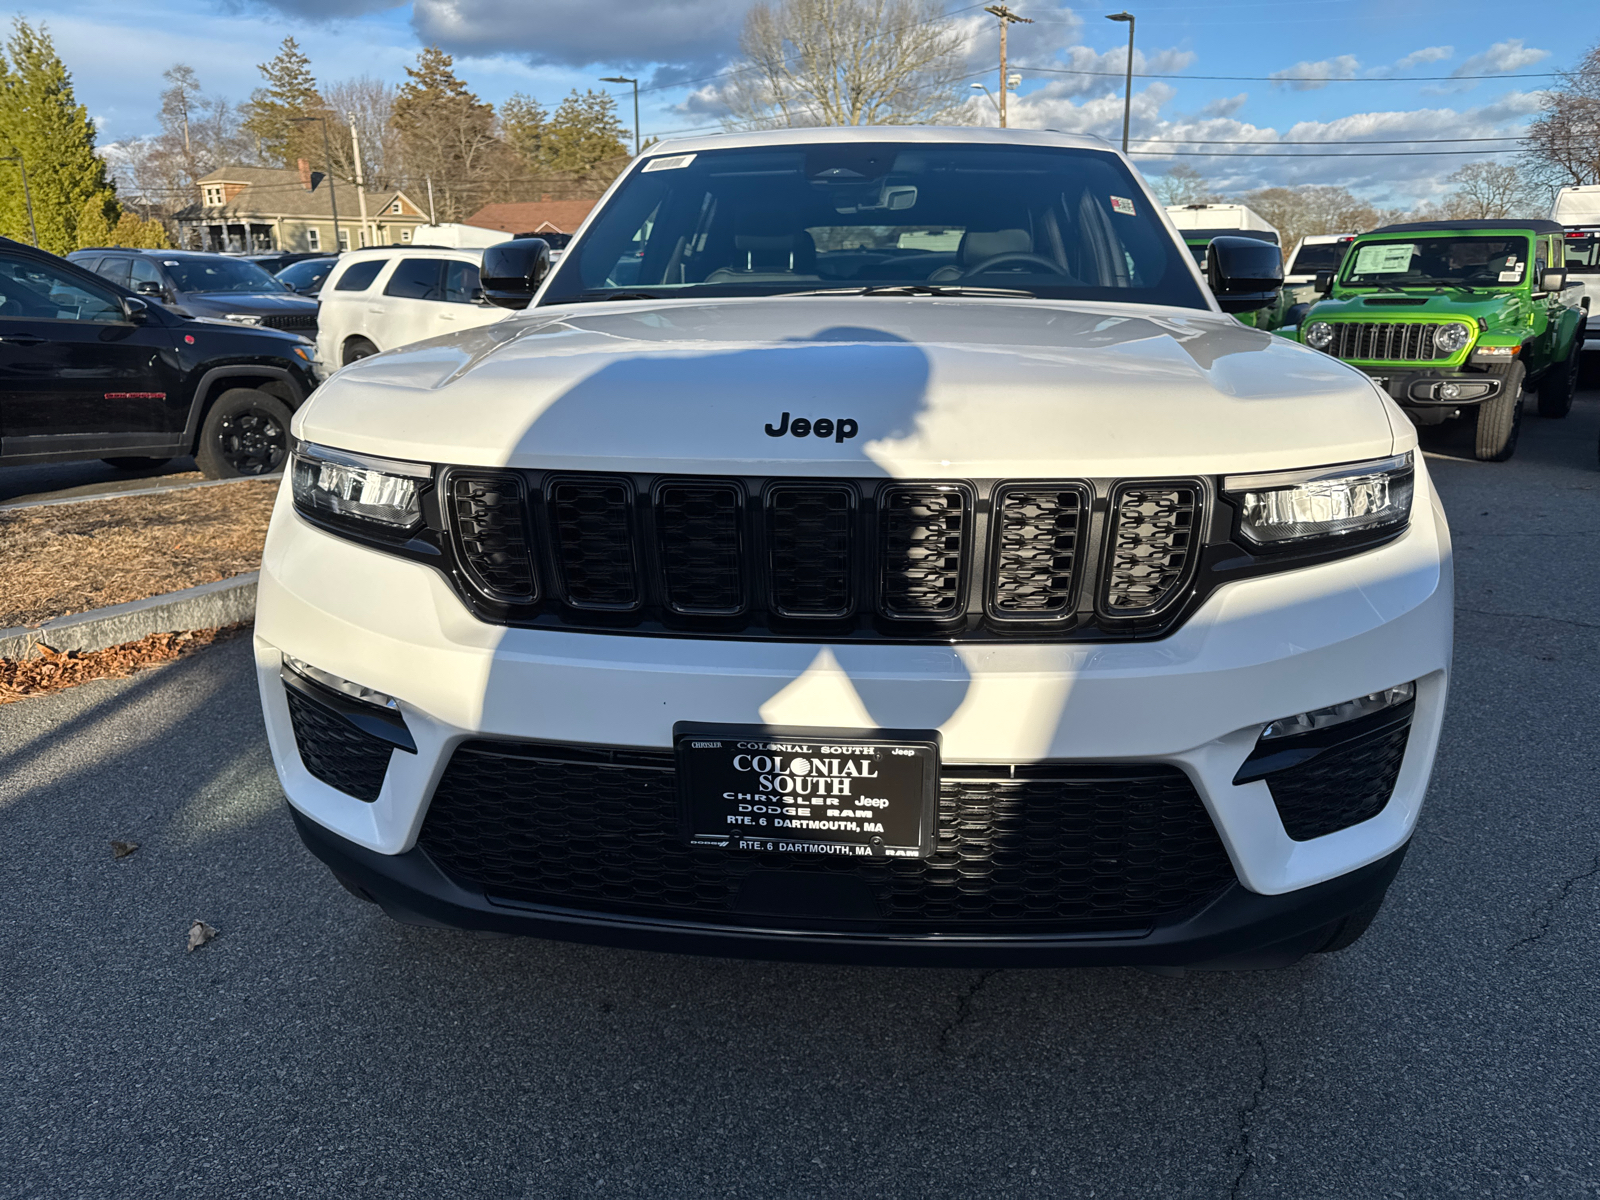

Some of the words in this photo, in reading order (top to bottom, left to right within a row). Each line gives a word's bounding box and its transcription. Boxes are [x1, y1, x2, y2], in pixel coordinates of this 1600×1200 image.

[765, 412, 859, 443] Jeep
[821, 746, 875, 755] SOUTH
[891, 748, 915, 757] Jeep
[759, 774, 852, 795] SOUTH
[722, 792, 840, 805] CHRYSLER
[855, 795, 889, 809] Jeep
[738, 804, 811, 816] DODGE
[827, 809, 873, 818] RAM
[727, 815, 756, 825] RTE.
[759, 817, 767, 826] 6
[774, 818, 860, 832] DARTMOUTH,
[864, 822, 884, 832] MA
[739, 841, 764, 850] RTE.
[767, 843, 774, 851] 6
[779, 843, 853, 856] DARTMOUTH,
[855, 846, 873, 856] MA
[885, 849, 919, 857] RAM
